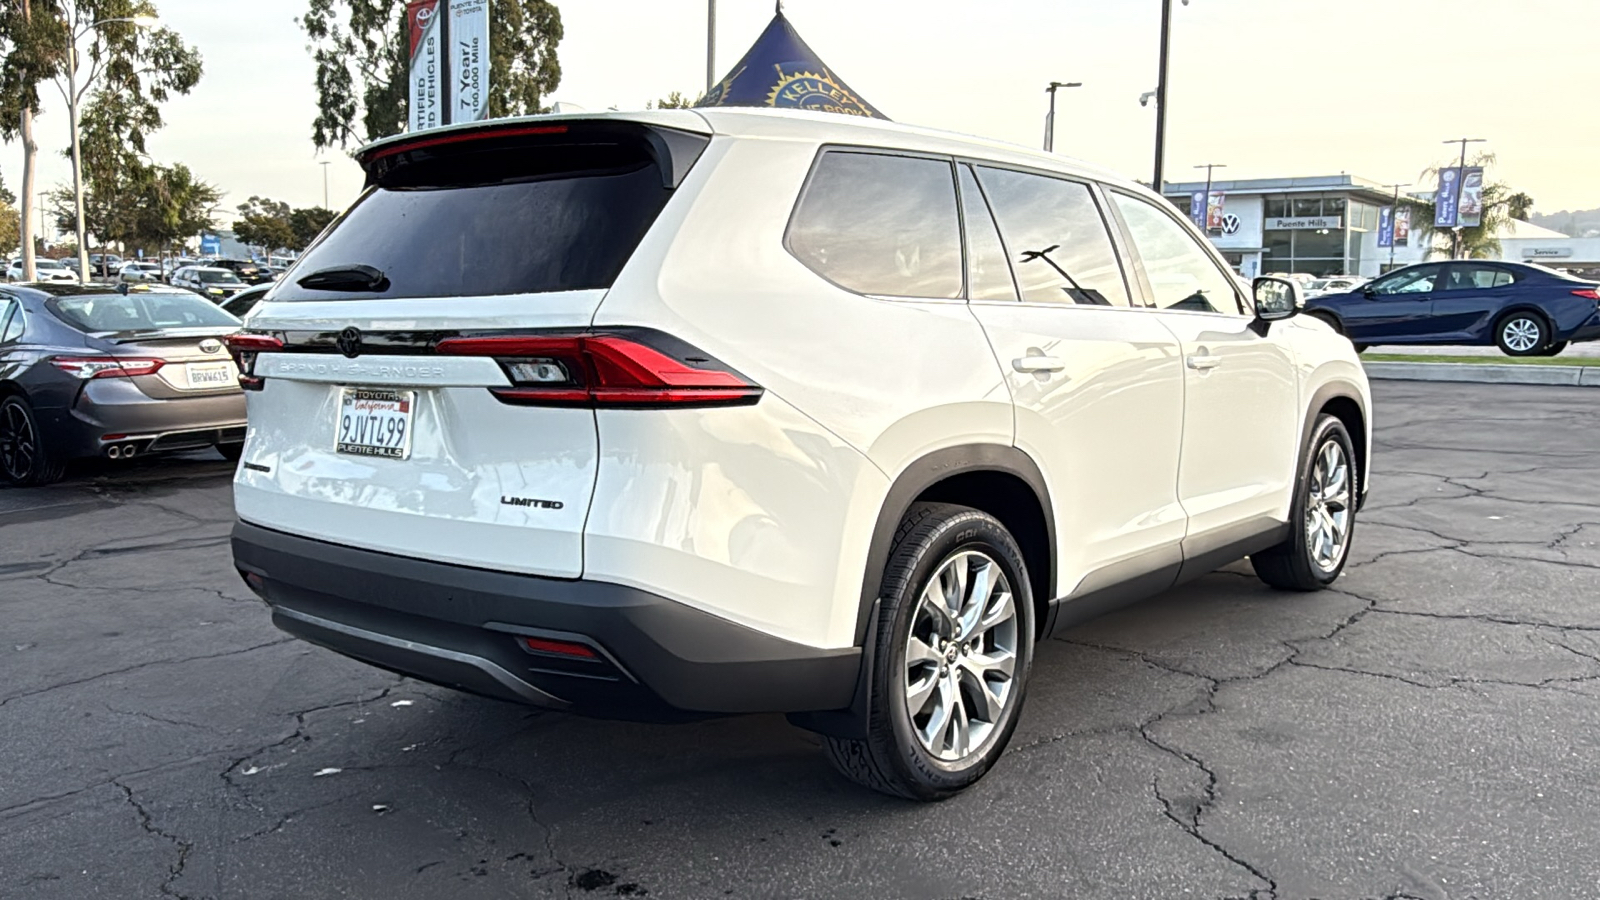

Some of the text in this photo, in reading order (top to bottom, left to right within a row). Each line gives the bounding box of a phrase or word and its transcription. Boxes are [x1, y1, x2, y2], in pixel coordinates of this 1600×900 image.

[427, 37, 436, 108] VEHICLES
[460, 41, 471, 110] 7 Year/
[472, 67, 480, 113] 100,000
[782, 81, 852, 105] KELLEY
[1277, 219, 1327, 228] Puente Hills
[1533, 248, 1559, 256] Service
[357, 391, 395, 400] TOYOTA
[354, 399, 395, 415] California
[341, 415, 406, 447] 9JVT499
[337, 445, 402, 457] PUENTE HILLS
[500, 495, 564, 510] LIMITED
